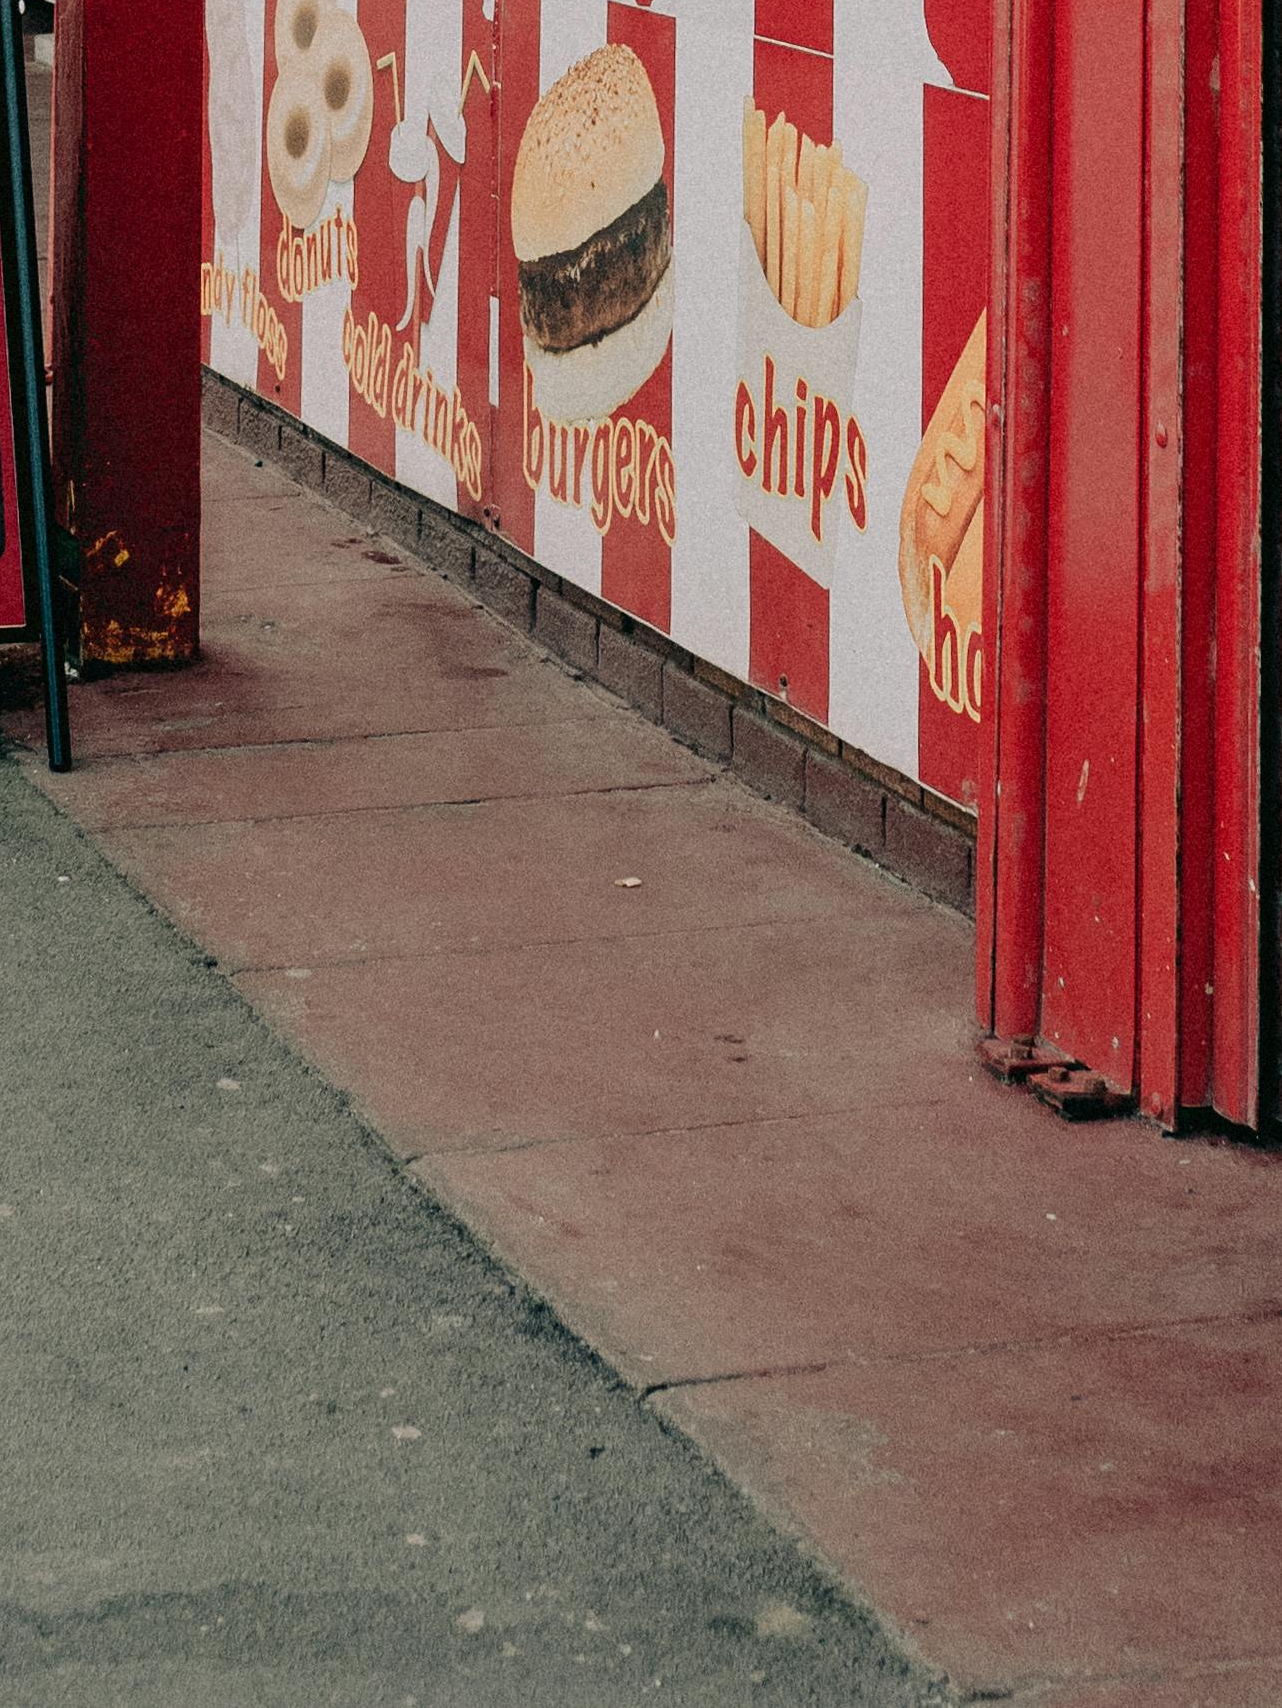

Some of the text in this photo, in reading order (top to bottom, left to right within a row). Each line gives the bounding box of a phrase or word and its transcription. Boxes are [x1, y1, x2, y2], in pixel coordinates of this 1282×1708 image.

[199, 259, 287, 380] ndy floss
[276, 203, 360, 303] donuts
[341, 308, 484, 502] cold drinks
[520, 363, 678, 547] burgers
[734, 354, 869, 543] chips
[926, 555, 984, 725] ho
